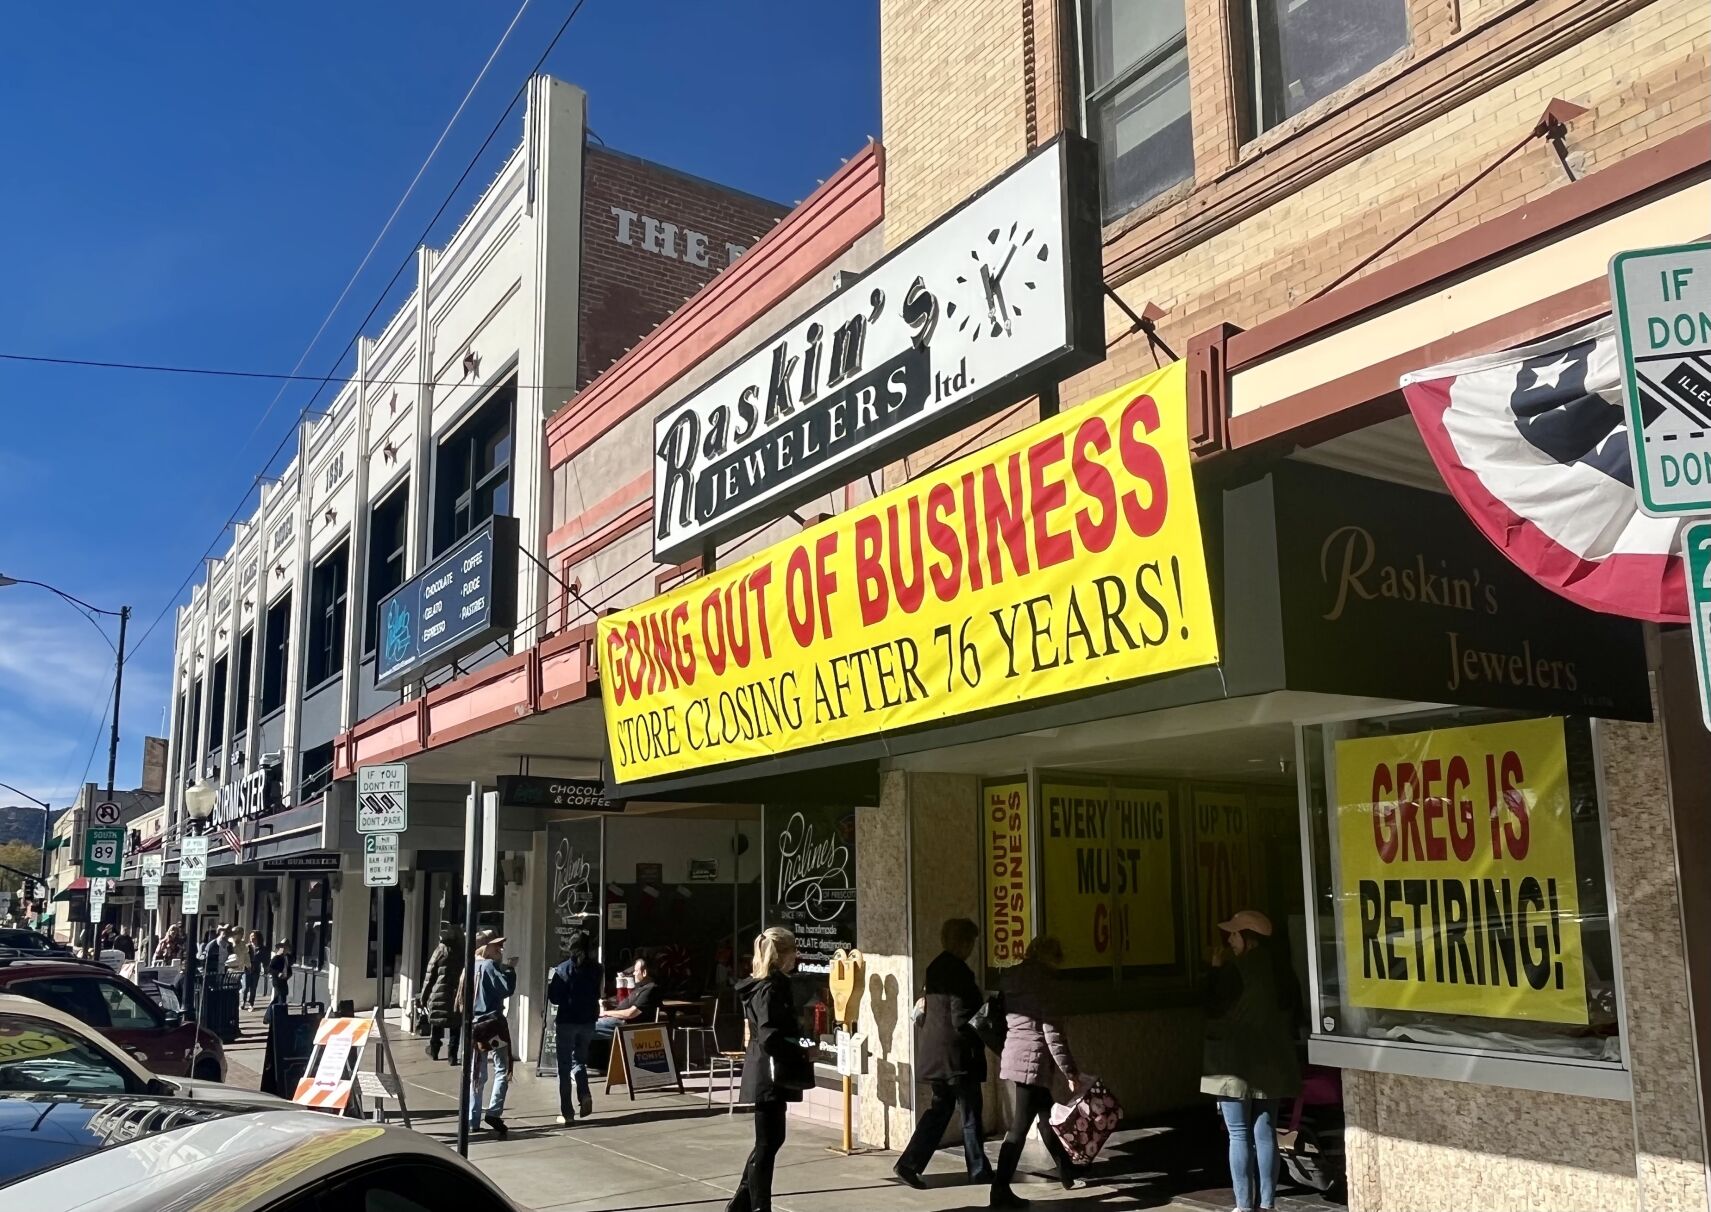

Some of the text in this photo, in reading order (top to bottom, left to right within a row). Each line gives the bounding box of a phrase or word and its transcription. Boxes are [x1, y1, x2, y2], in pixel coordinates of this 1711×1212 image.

[610, 206, 708, 268] THE
[1661, 268, 1693, 301] IF
[657, 276, 941, 541] Raskin's
[934, 357, 976, 404] ltd.
[704, 366, 908, 517] JEWELERS
[607, 394, 1169, 706] GOING OUT OF BUSINESS
[1321, 526, 1498, 621] Raskin's
[425, 572, 454, 599] CHOCOLATE
[617, 555, 1190, 766] STORE CLOSING AFTER 76 YEARS!
[1445, 632, 1578, 692] Jewelers
[389, 781, 400, 789] FIT
[554, 795, 563, 804] &
[1372, 751, 1530, 862] GREG IS
[94, 831, 117, 839] SOUTH
[95, 846, 114, 859] 89
[367, 839, 374, 852] 2
[991, 793, 1009, 960] GOING OUT OF
[1008, 790, 1025, 960] BUSINESS
[1359, 876, 1564, 990] RETIRING!
